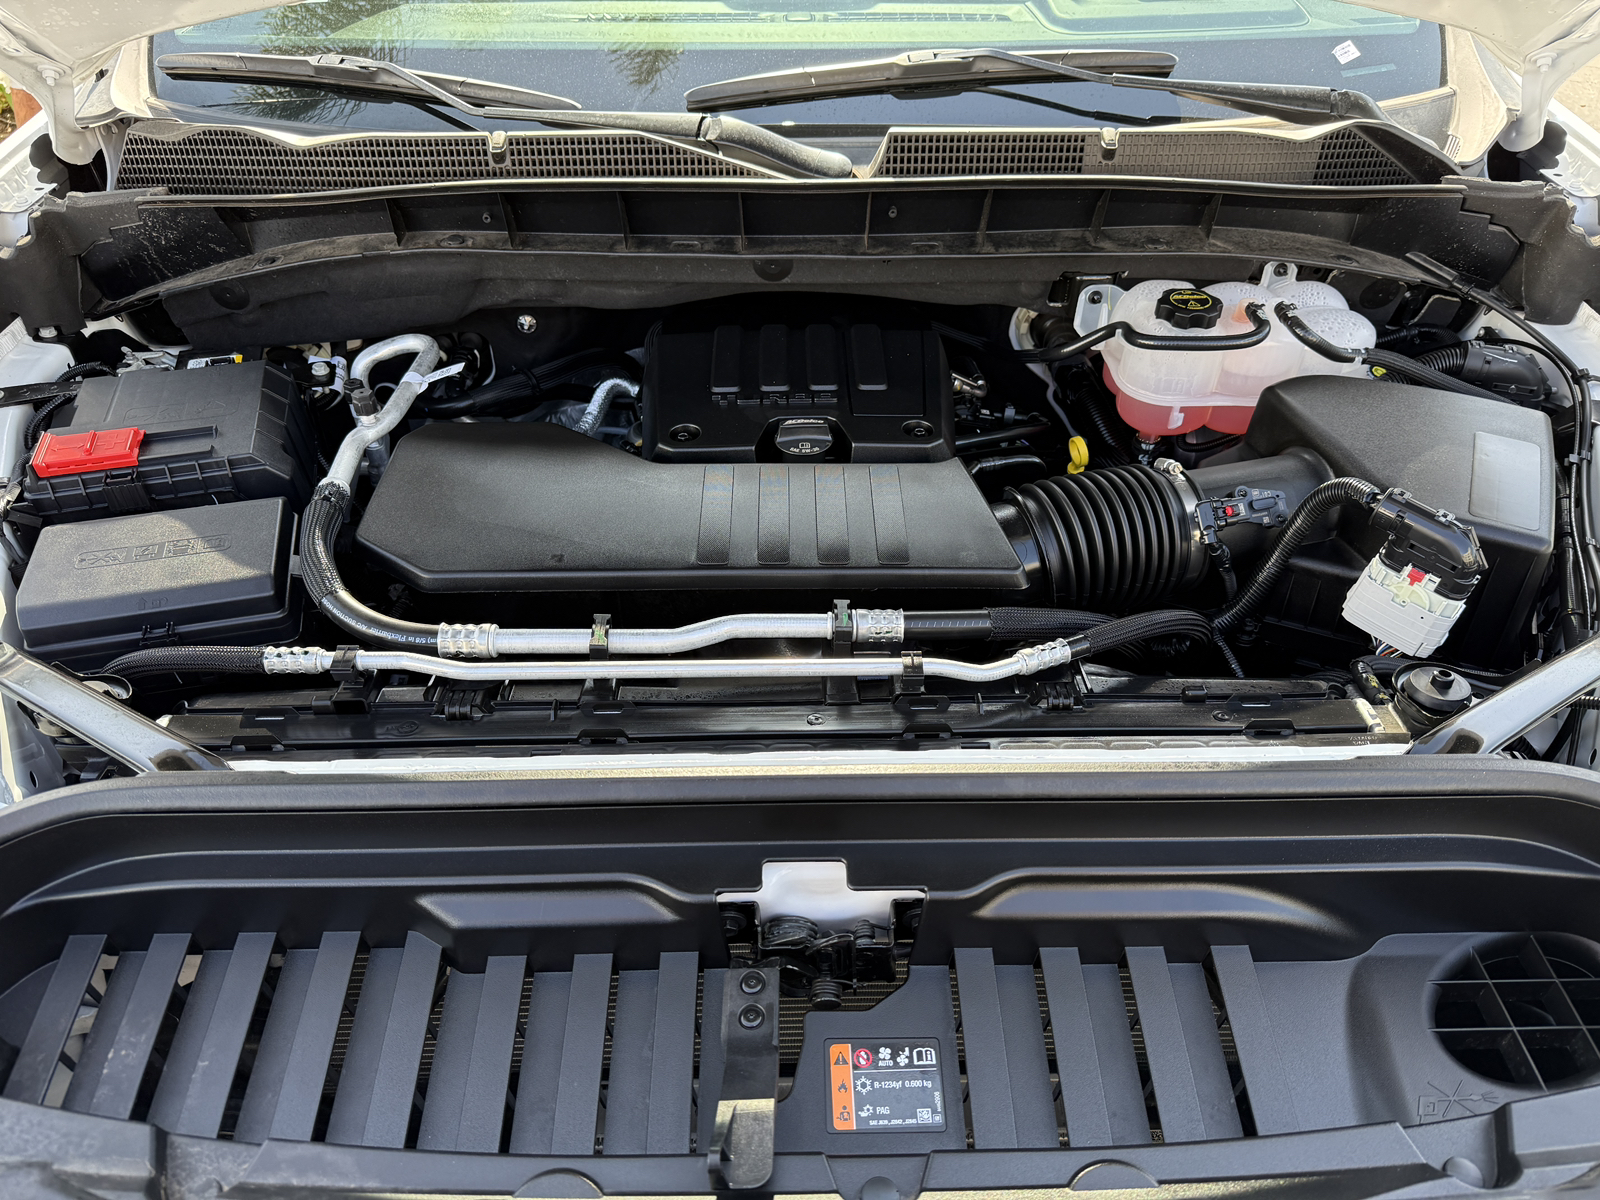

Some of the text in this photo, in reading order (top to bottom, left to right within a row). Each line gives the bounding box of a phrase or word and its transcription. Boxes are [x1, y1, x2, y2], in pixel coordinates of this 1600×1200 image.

[332, 607, 357, 625] SUCTION
[356, 621, 368, 631] A/C
[370, 627, 407, 642] Flexbarrier
[874, 1079, 932, 1089] R-1234yf 0.600 kg
